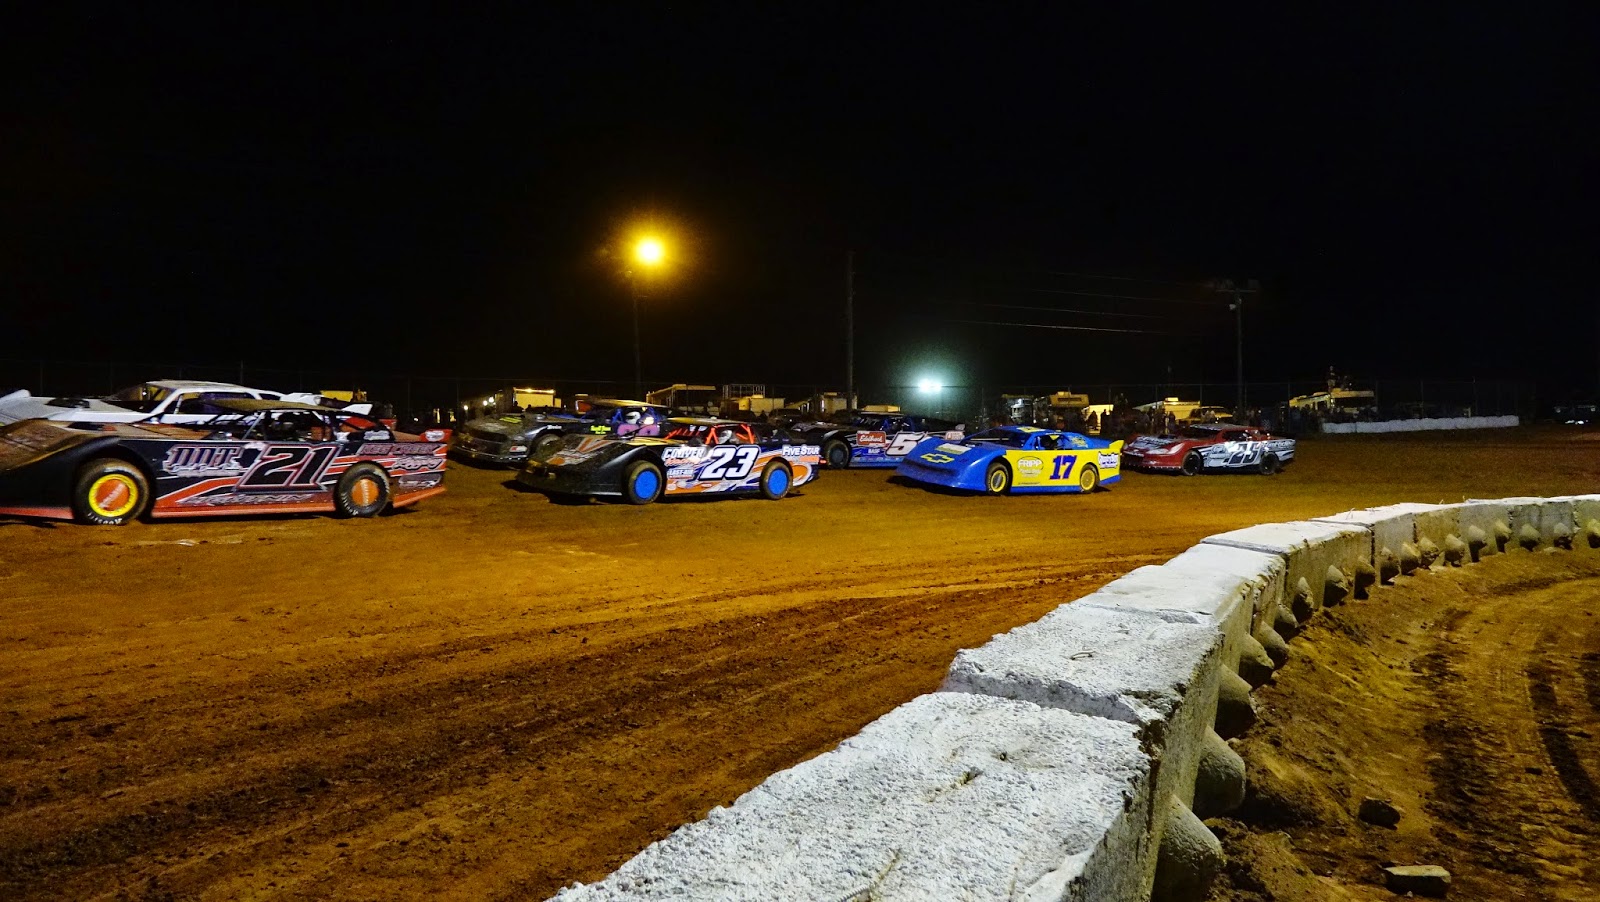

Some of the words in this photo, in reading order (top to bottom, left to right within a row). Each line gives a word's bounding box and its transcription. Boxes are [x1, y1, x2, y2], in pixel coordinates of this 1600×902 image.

[782, 445, 800, 456] FIVE
[801, 444, 820, 456] STAR
[886, 432, 924, 456] 5
[243, 444, 338, 487] 21
[698, 445, 760, 480] 23
[1018, 459, 1043, 468] FRIPP
[1049, 455, 1078, 480] 17
